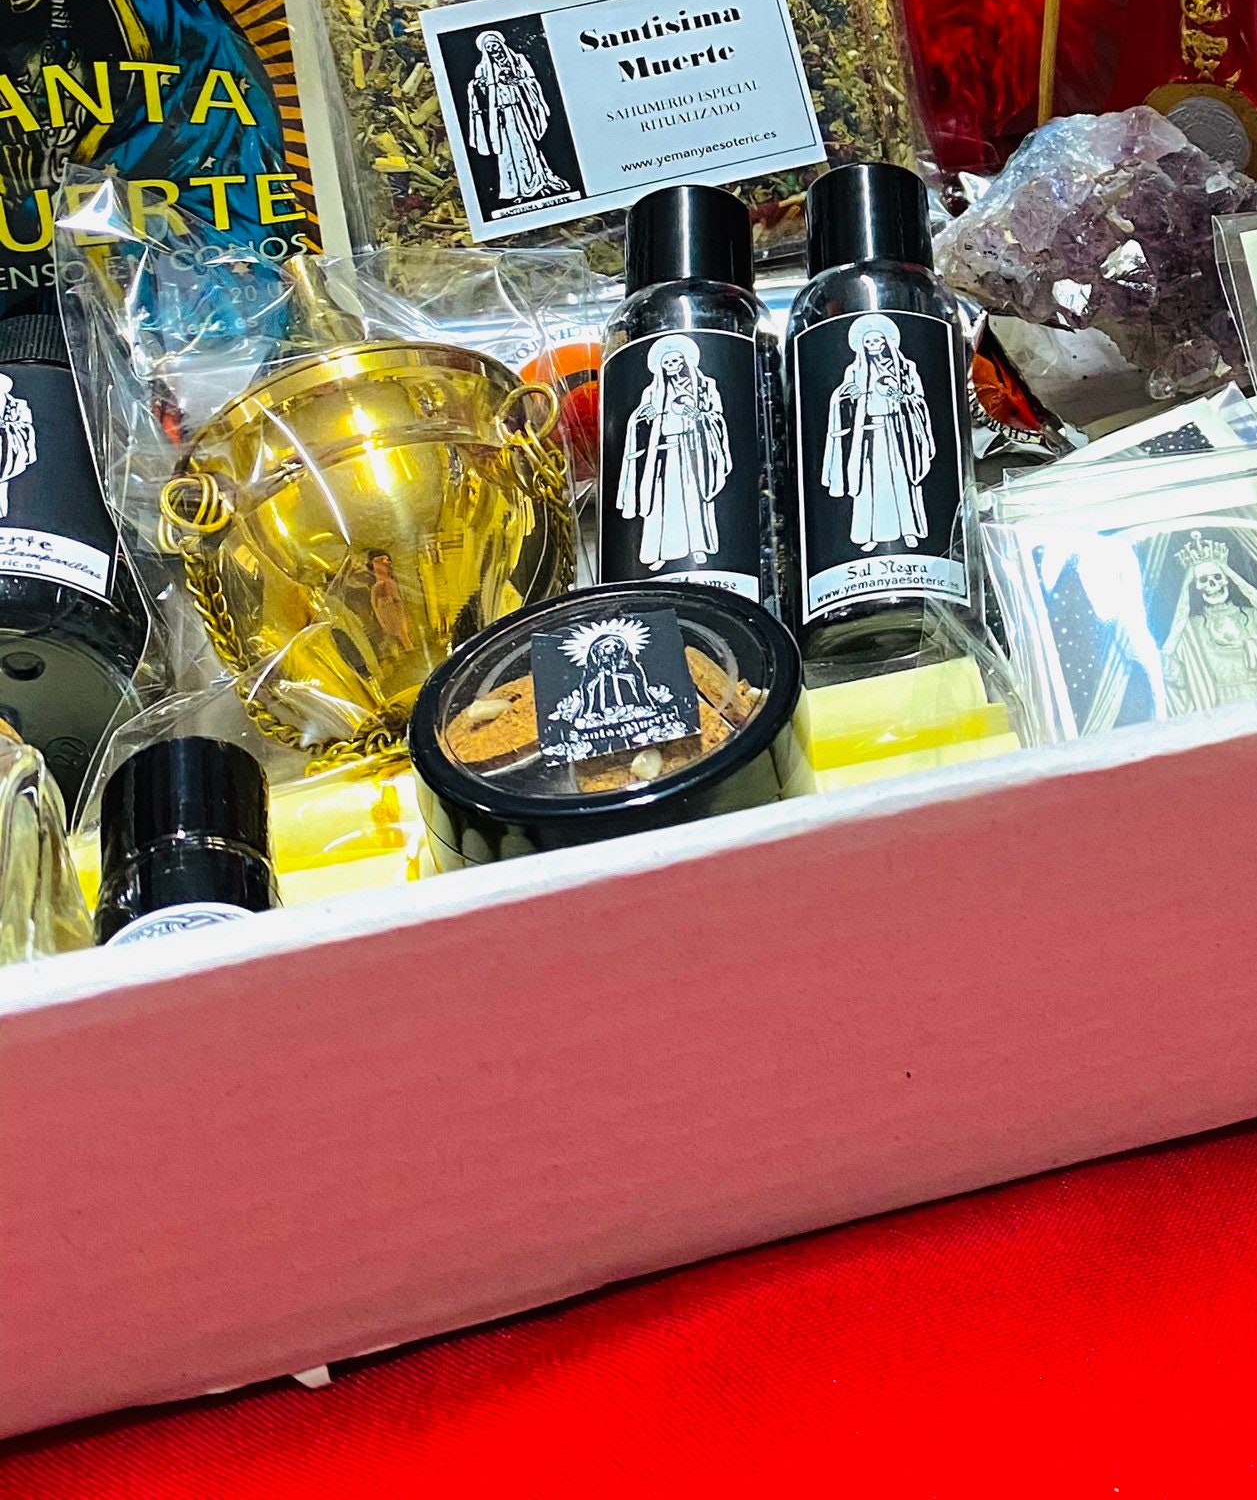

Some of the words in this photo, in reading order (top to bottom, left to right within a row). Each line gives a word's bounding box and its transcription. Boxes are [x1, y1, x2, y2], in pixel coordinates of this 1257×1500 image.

[617, 43, 735, 83] Muerte
[606, 93, 694, 122] SAHUMERIO
[697, 80, 760, 103] ESPECIAL
[639, 101, 742, 133] RITUALIZADO
[621, 129, 778, 173] www.yemanyaesoteric.es
[846, 560, 872, 581] Sal
[879, 560, 928, 576] Negra
